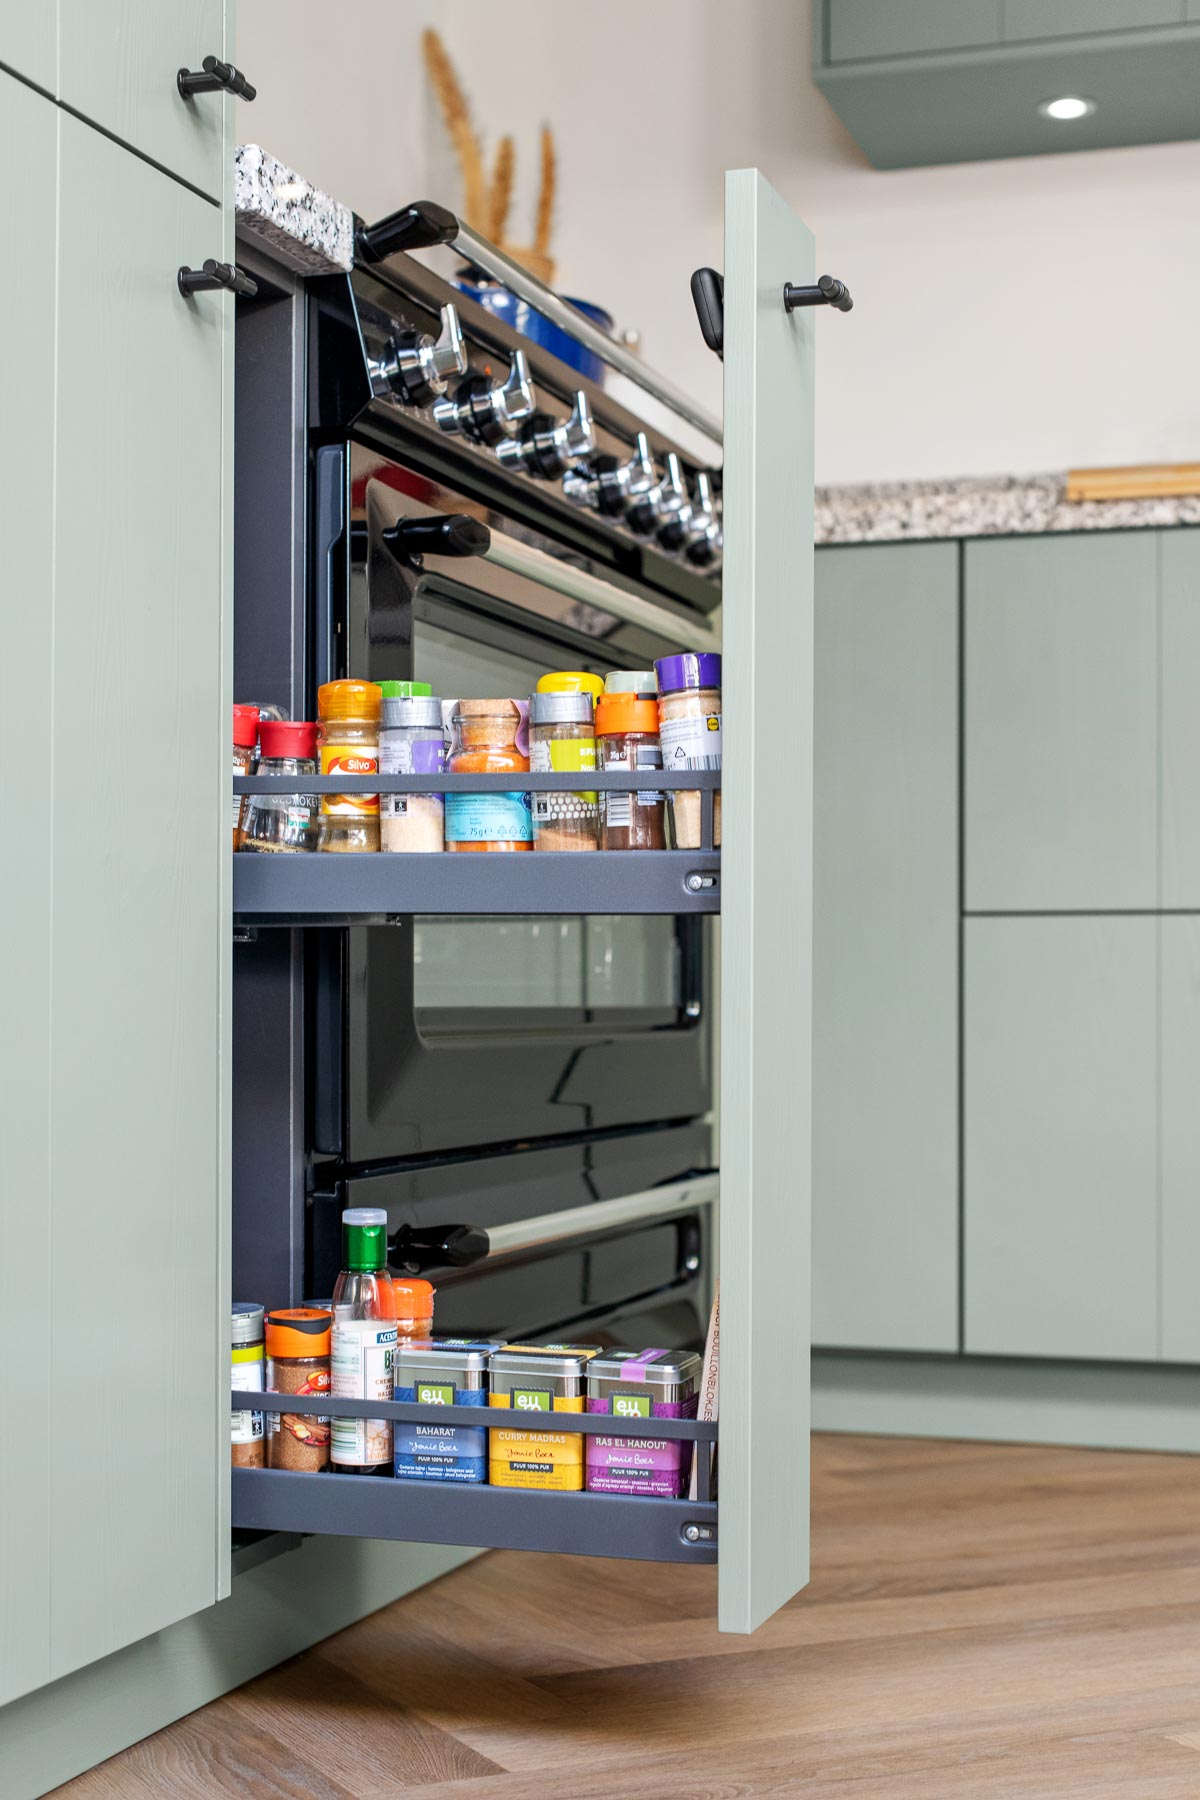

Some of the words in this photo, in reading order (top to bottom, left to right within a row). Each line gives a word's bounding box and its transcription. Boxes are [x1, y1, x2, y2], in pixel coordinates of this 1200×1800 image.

[347, 760, 370, 771] Silvo
[416, 1426, 456, 1437] BAHARAT
[498, 1431, 528, 1441] CURRY
[529, 1433, 566, 1444] MADRAS
[595, 1437, 613, 1446] RAS
[614, 1438, 625, 1447] EL
[627, 1439, 667, 1450] HANOUT
